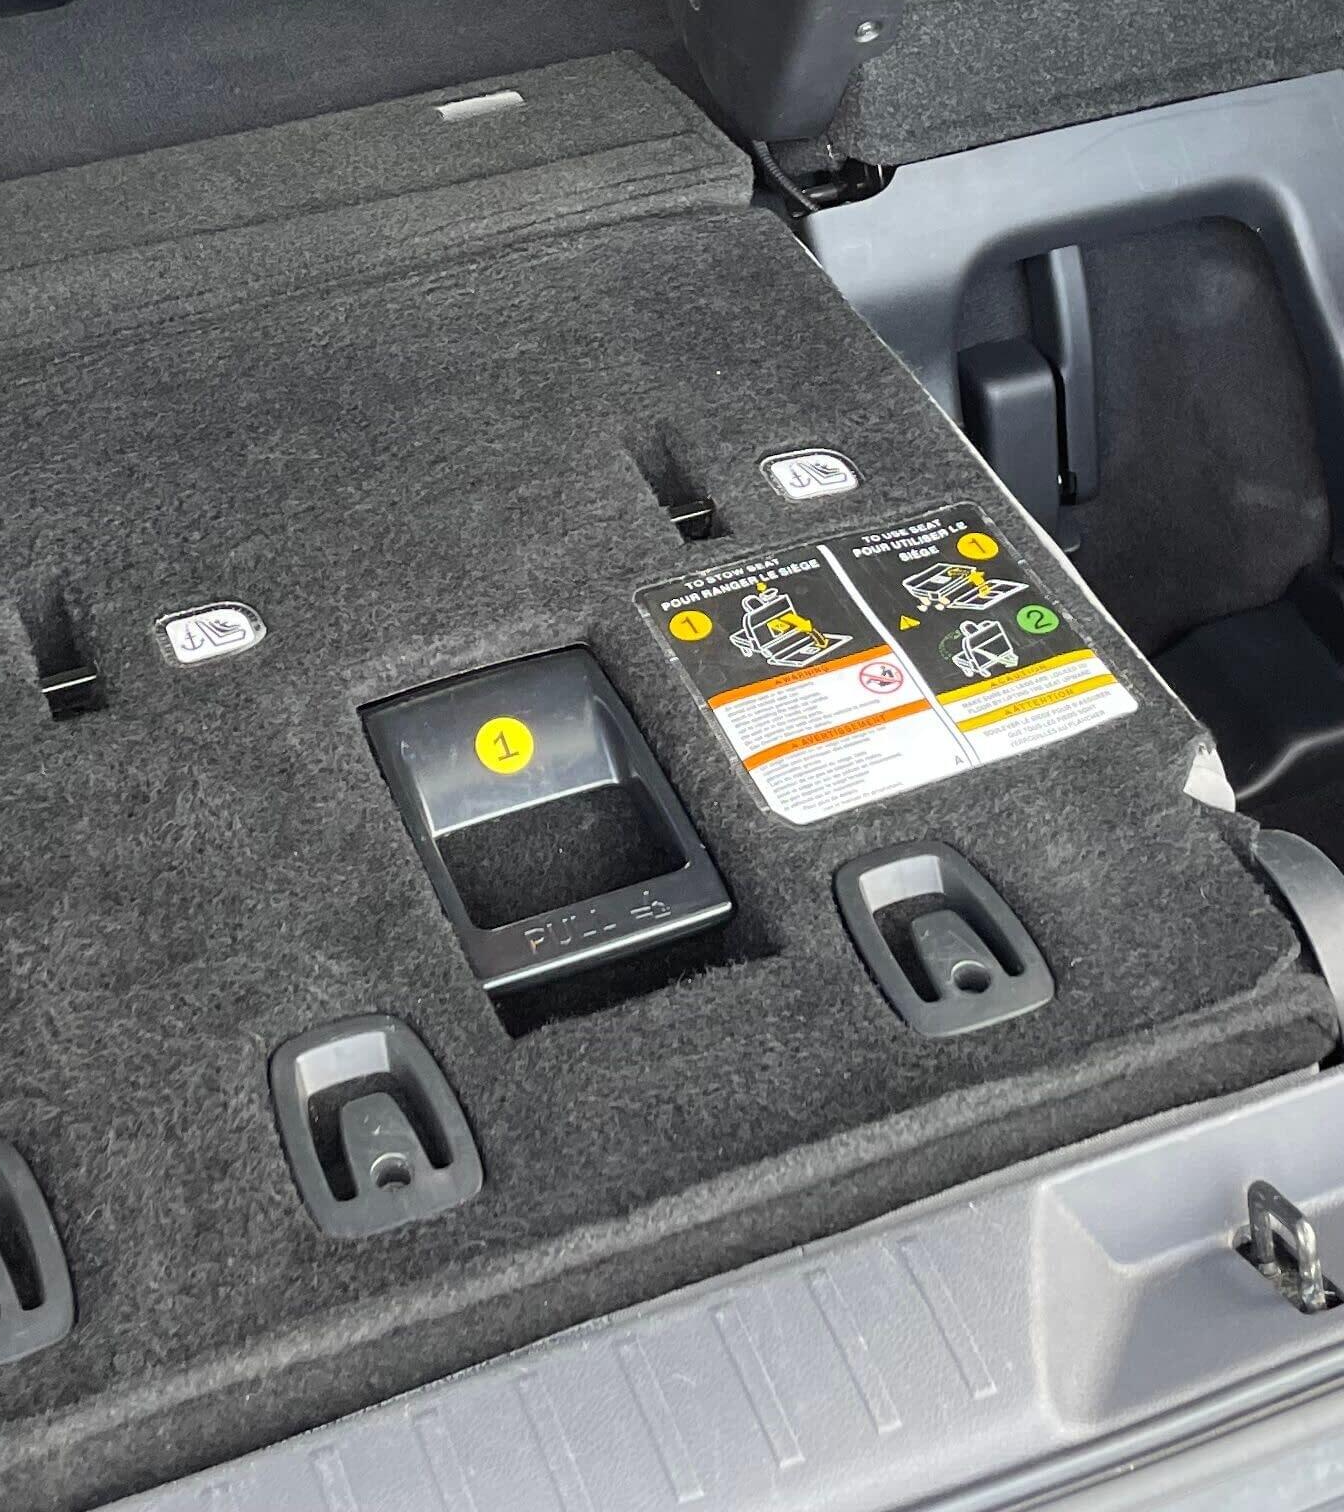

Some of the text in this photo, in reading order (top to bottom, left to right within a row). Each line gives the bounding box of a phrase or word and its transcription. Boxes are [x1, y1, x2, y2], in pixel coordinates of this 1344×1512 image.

[852, 521, 968, 558] POUR UTILISER LE
[861, 518, 942, 544] TO USE SEAT
[660, 591, 701, 612] POUR
[701, 575, 758, 599] RANGER
[759, 569, 779, 583] LE
[684, 558, 780, 591] TO STOW SEAT
[1027, 609, 1052, 629] 2
[1013, 688, 1074, 712] ATTENTION
[492, 730, 521, 763] 1
